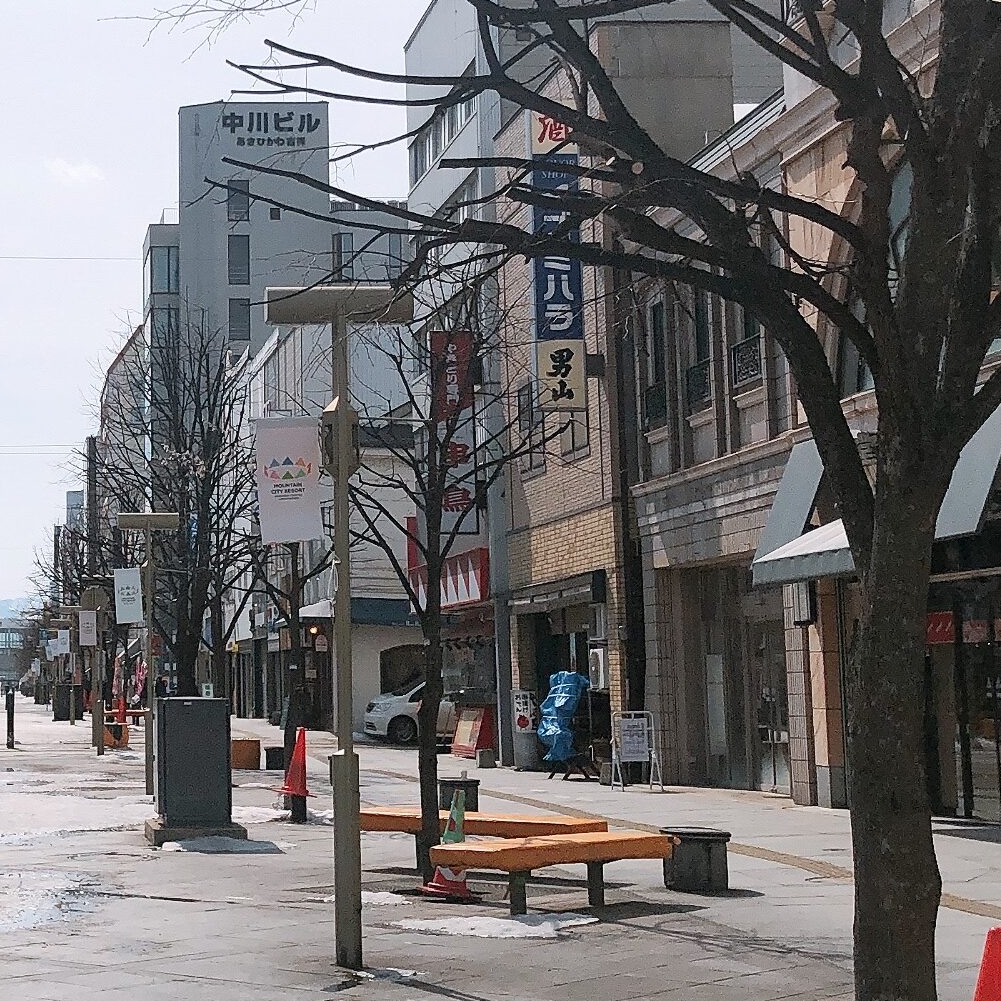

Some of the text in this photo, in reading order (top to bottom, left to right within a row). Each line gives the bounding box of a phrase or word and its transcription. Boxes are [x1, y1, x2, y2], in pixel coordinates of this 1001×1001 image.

[221, 111, 321, 134] 中川ビル
[545, 347, 575, 402] 男山
